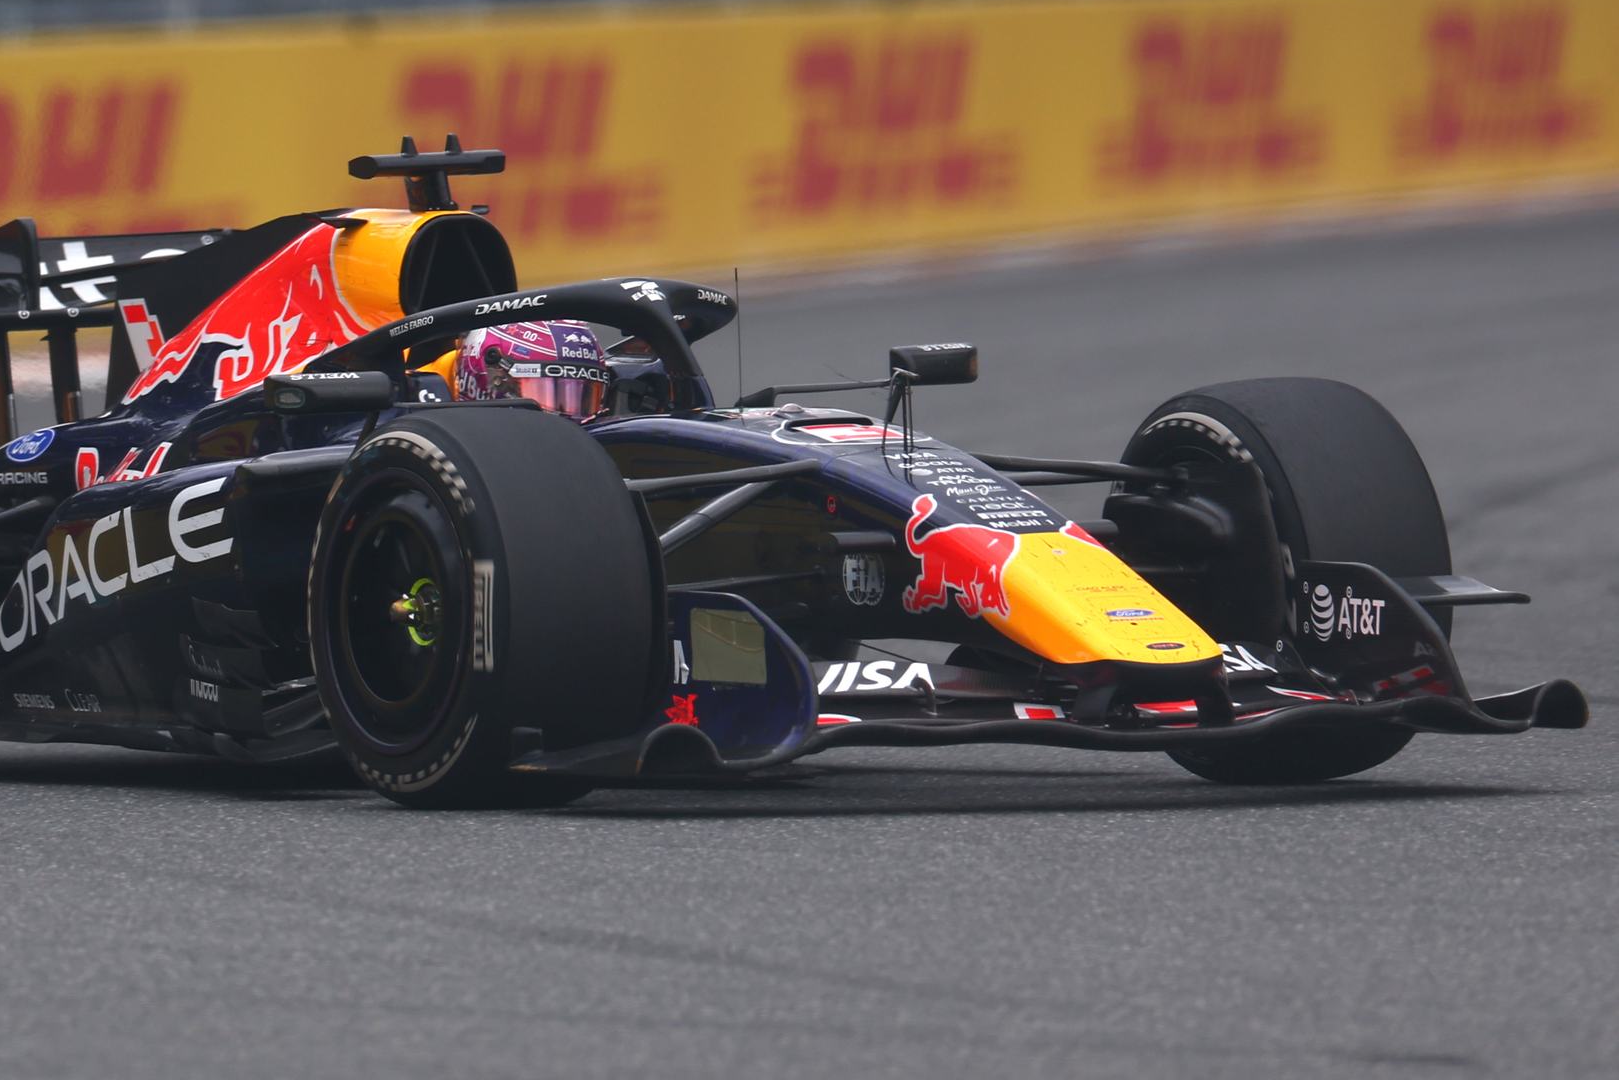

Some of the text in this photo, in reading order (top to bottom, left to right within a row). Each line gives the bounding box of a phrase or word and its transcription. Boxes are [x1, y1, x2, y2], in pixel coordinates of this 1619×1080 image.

[792, 32, 980, 213] DHL
[474, 294, 548, 316] DAMAC
[697, 289, 728, 306] DAMAC
[388, 315, 435, 338] WELLS FARGO
[562, 346, 598, 361] Red Bull
[291, 372, 360, 381] WELLS
[545, 364, 610, 384] ORACLE
[956, 496, 1026, 504] CARLYLE
[988, 519, 1042, 529] Mobil
[846, 557, 881, 593] FIA
[1337, 597, 1385, 636] AT&T
[13, 692, 56, 709] SIEMENS
